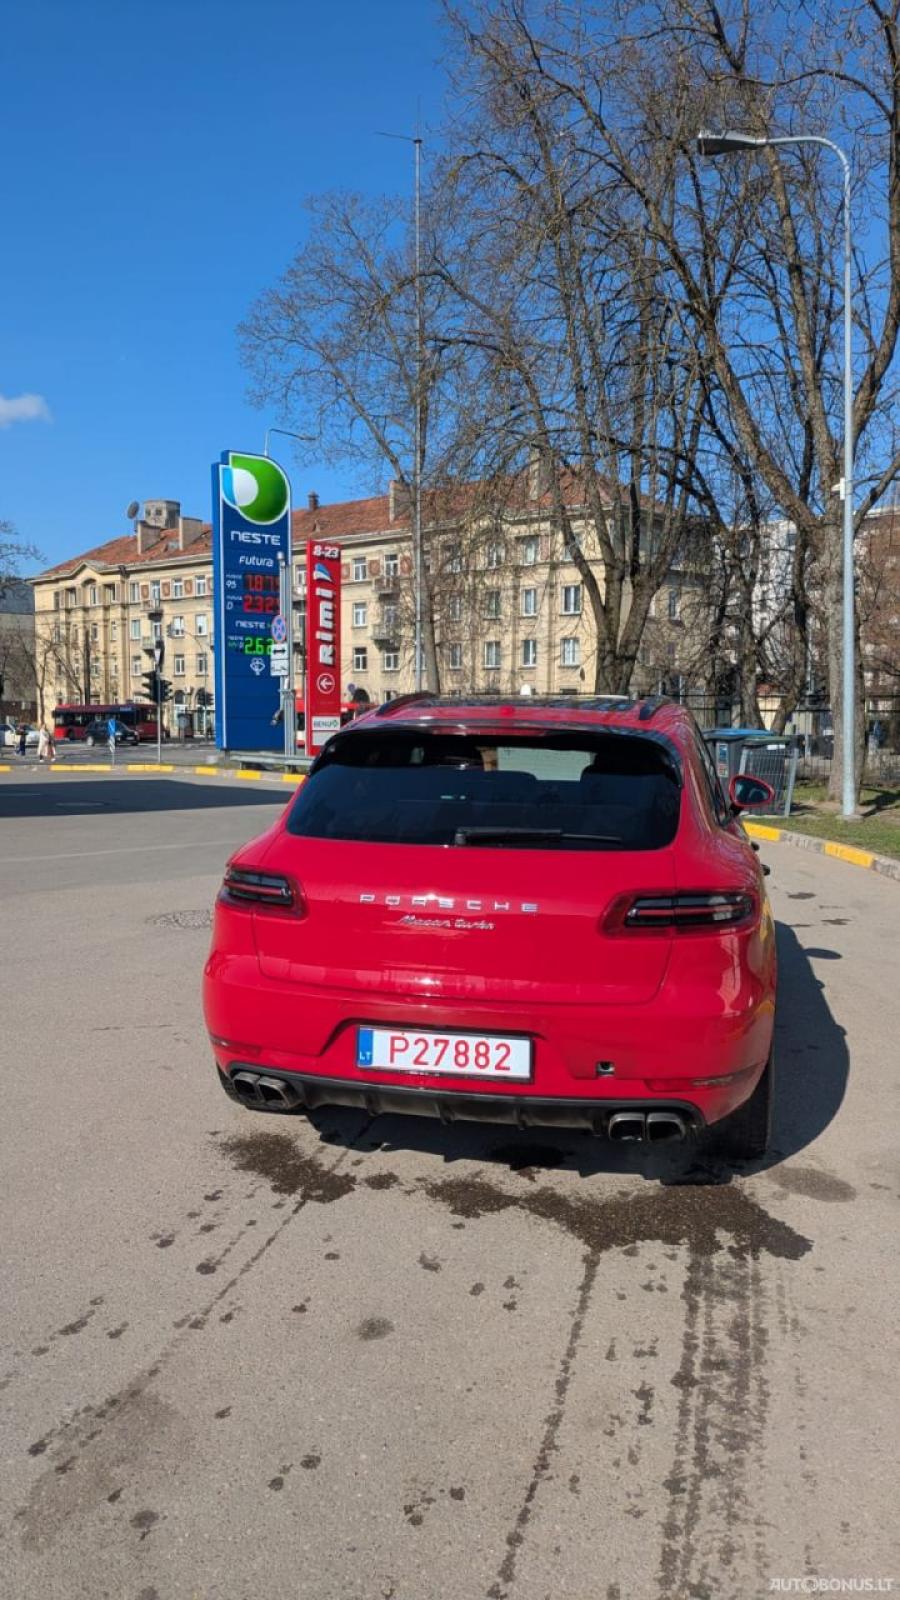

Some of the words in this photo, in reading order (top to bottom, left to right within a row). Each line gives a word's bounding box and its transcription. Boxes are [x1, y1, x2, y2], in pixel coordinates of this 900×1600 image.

[230, 530, 281, 546] NESTE
[313, 544, 340, 559] 8-23
[225, 579, 237, 589] 95
[226, 601, 234, 610] D
[235, 620, 266, 630] NESTE
[360, 893, 538, 912] PORSCHE
[359, 1051, 371, 1061] LT
[389, 1035, 512, 1071] P27882
